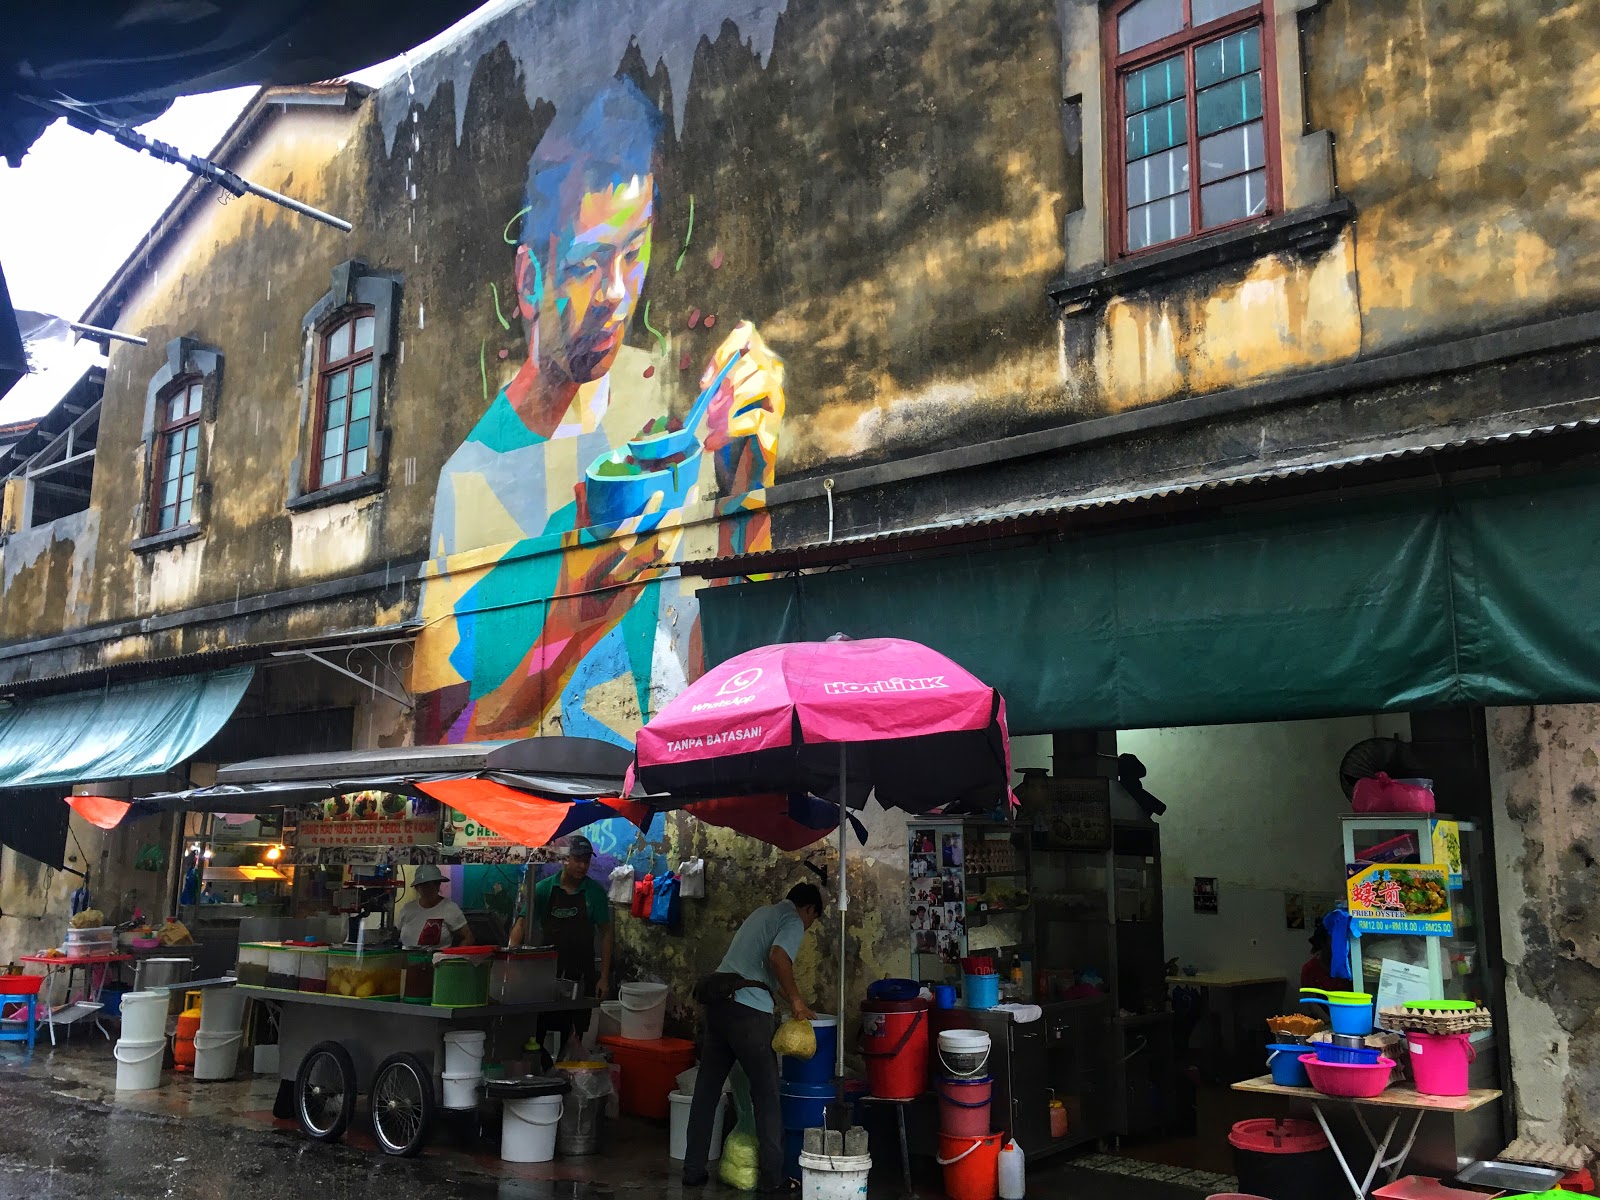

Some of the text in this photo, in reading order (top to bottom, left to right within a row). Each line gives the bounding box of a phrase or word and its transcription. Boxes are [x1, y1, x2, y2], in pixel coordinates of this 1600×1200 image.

[691, 695, 756, 713] WhatsApp
[667, 726, 762, 752] TANPA BATASAN!
[320, 824, 333, 835] ROAD
[334, 823, 353, 834] FAMOUS
[355, 823, 377, 834] TEOCHEW
[380, 822, 401, 834] CHENDUL
[404, 821, 413, 833] ICE
[414, 821, 436, 833] KACANG
[1375, 910, 1406, 918] OYSTER
[1358, 920, 1383, 930] RM12.00
[1391, 921, 1417, 931] RM18.00
[1424, 922, 1451, 933] RM25.00
